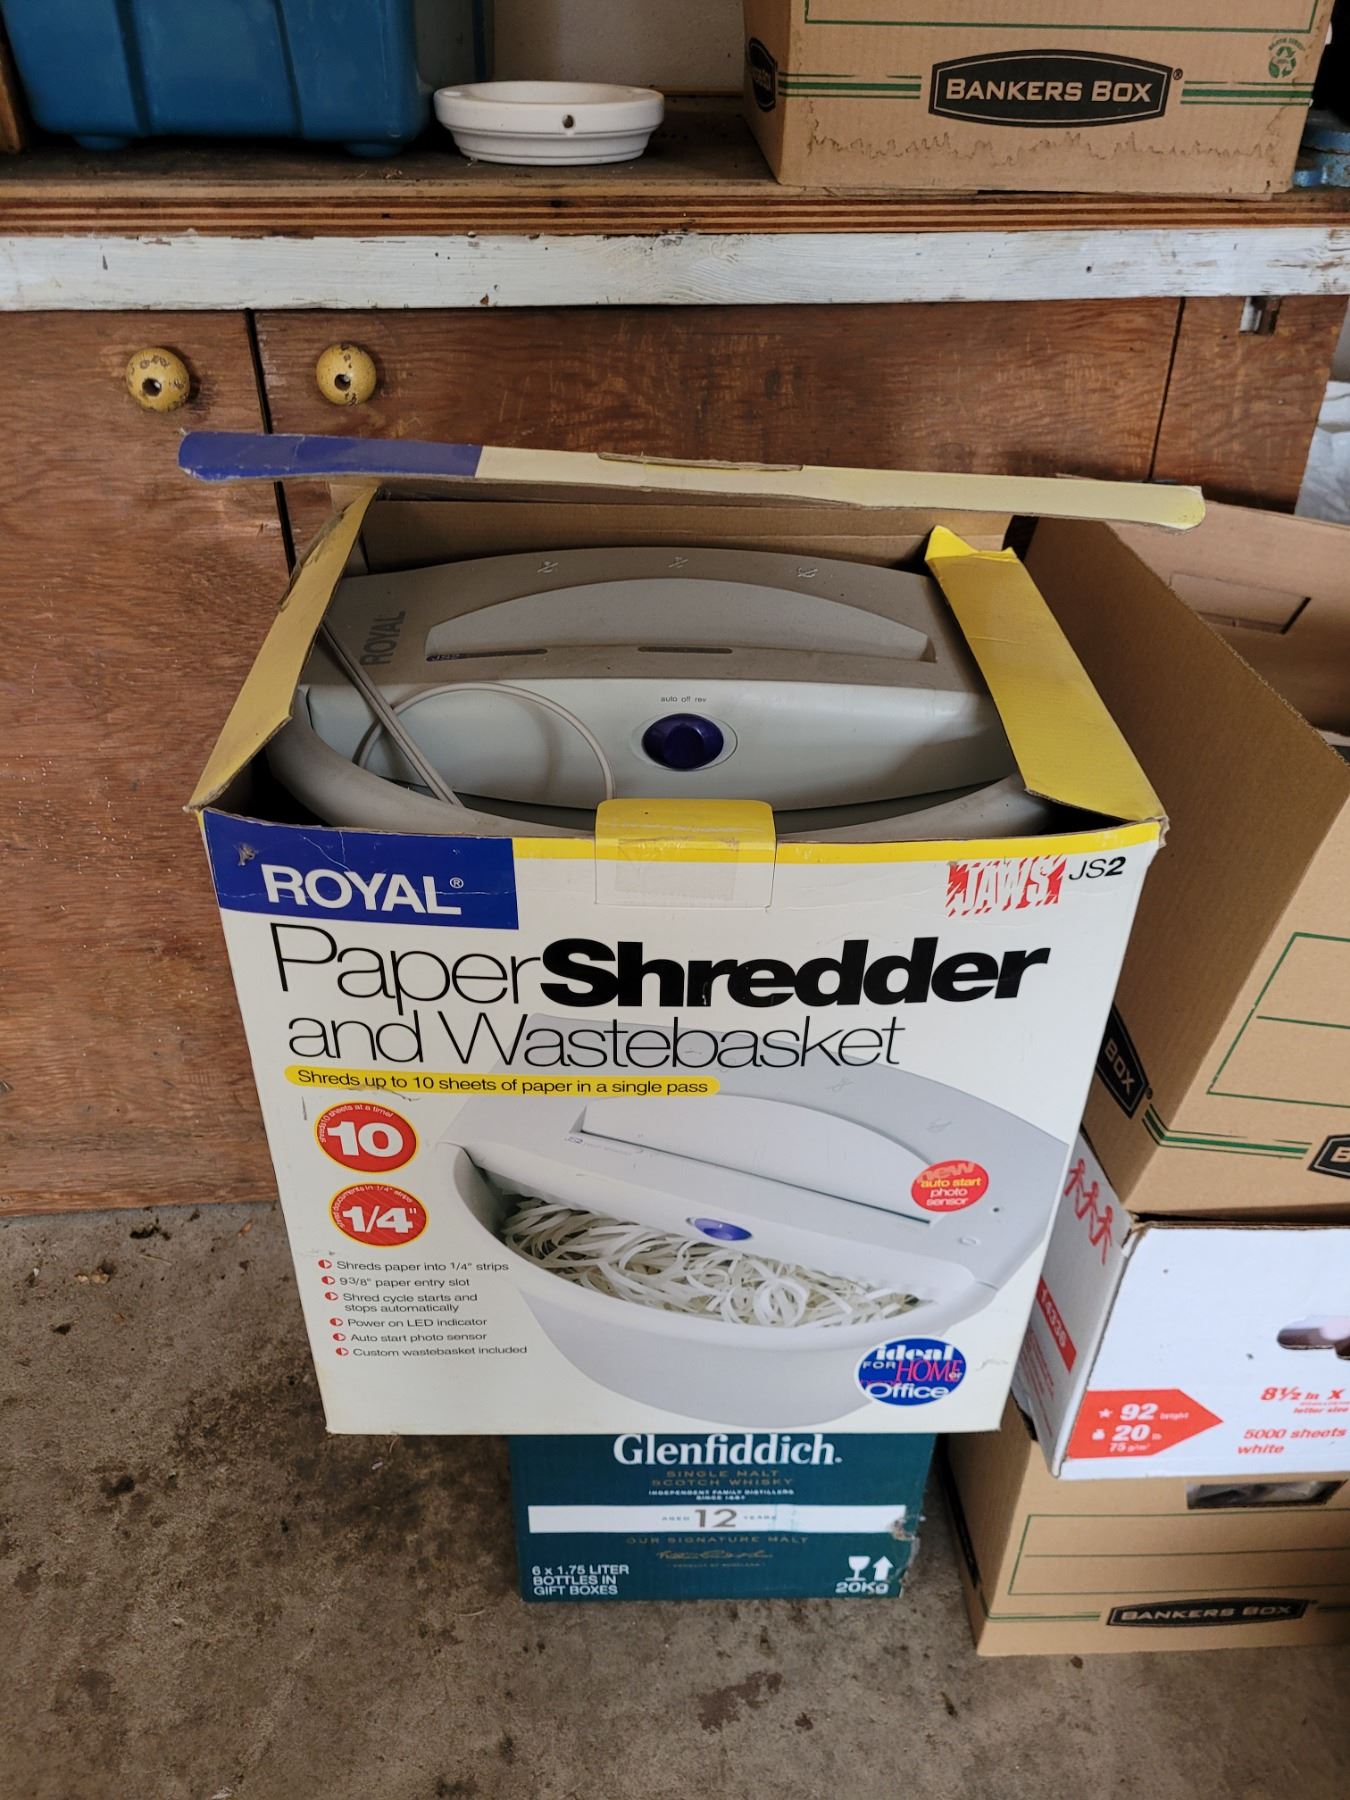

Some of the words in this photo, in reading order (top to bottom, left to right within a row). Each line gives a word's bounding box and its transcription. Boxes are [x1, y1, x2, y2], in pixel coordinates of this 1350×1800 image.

[946, 78, 1082, 101] BANKERS
[1091, 80, 1153, 103] BOX
[360, 610, 405, 665] ROYAL
[1069, 856, 1126, 881] JS2
[952, 856, 1054, 910] JAWS
[288, 1009, 423, 1063] and
[437, 1010, 906, 1069] Wastebasket
[1104, 1037, 1135, 1095] BOX
[297, 1069, 360, 1086] Shreds
[364, 1077, 387, 1089] up
[390, 1075, 408, 1088] to
[414, 1076, 435, 1089] 10
[439, 1077, 497, 1091] sheets
[501, 1079, 518, 1091] of
[522, 1081, 573, 1095] paper
[577, 1080, 591, 1092] in
[596, 1082, 608, 1093] a
[612, 1080, 663, 1095] single
[667, 1081, 708, 1095] pass
[327, 1121, 404, 1157] 10
[921, 1179, 950, 1188] auto
[953, 1177, 981, 1187] start
[930, 1187, 968, 1198] photo
[927, 1198, 968, 1206] sensor
[342, 1205, 417, 1233] 1/4"
[336, 1261, 382, 1271] Shreds
[385, 1263, 421, 1273] paper
[424, 1262, 447, 1271] into
[476, 1261, 509, 1272] strips
[375, 1279, 411, 1288] paper
[414, 1279, 445, 1288] entry
[449, 1278, 470, 1287] slot
[342, 1292, 380, 1302] Shred
[382, 1293, 414, 1304] cycle
[417, 1293, 451, 1302] starts
[454, 1293, 478, 1302] and
[344, 1304, 378, 1313] stops
[380, 1303, 459, 1314] automatically
[347, 1318, 385, 1327] Power
[407, 1318, 434, 1327] LED
[437, 1318, 488, 1327] indicator
[350, 1334, 378, 1342] Auto
[381, 1333, 407, 1342] start
[410, 1333, 444, 1343] photo
[447, 1332, 488, 1341] sensor
[352, 1349, 400, 1357] Custom
[402, 1347, 475, 1356] wastebasket
[478, 1345, 528, 1354] included
[863, 1361, 896, 1369] FOR
[896, 1360, 962, 1382] HOME
[867, 1383, 949, 1398] Office
[1120, 1403, 1159, 1421] 92
[1112, 1424, 1150, 1441] 20
[1244, 1429, 1287, 1439] 5000
[1290, 1428, 1346, 1438] sheets
[1109, 1442, 1126, 1452] 75
[1238, 1444, 1285, 1454] white
[667, 1469, 729, 1477] SINGLE
[737, 1469, 779, 1477] MALT
[652, 1479, 720, 1487] SCOTCH
[729, 1478, 793, 1486] WHISKY
[695, 1509, 737, 1528] 12
[626, 1536, 659, 1544] OUR
[668, 1536, 760, 1544] SIGNATURE
[768, 1536, 809, 1544] MALT
[532, 1565, 541, 1575] 6
[557, 1565, 585, 1575] 1.75
[589, 1564, 629, 1575] LITER
[533, 1575, 598, 1586] BOTTLES
[602, 1575, 616, 1585] IN
[534, 1586, 566, 1596] GIFT
[569, 1585, 618, 1595] BOXES
[1121, 1608, 1234, 1621] BANKERS
[1242, 1605, 1292, 1617] BOX
